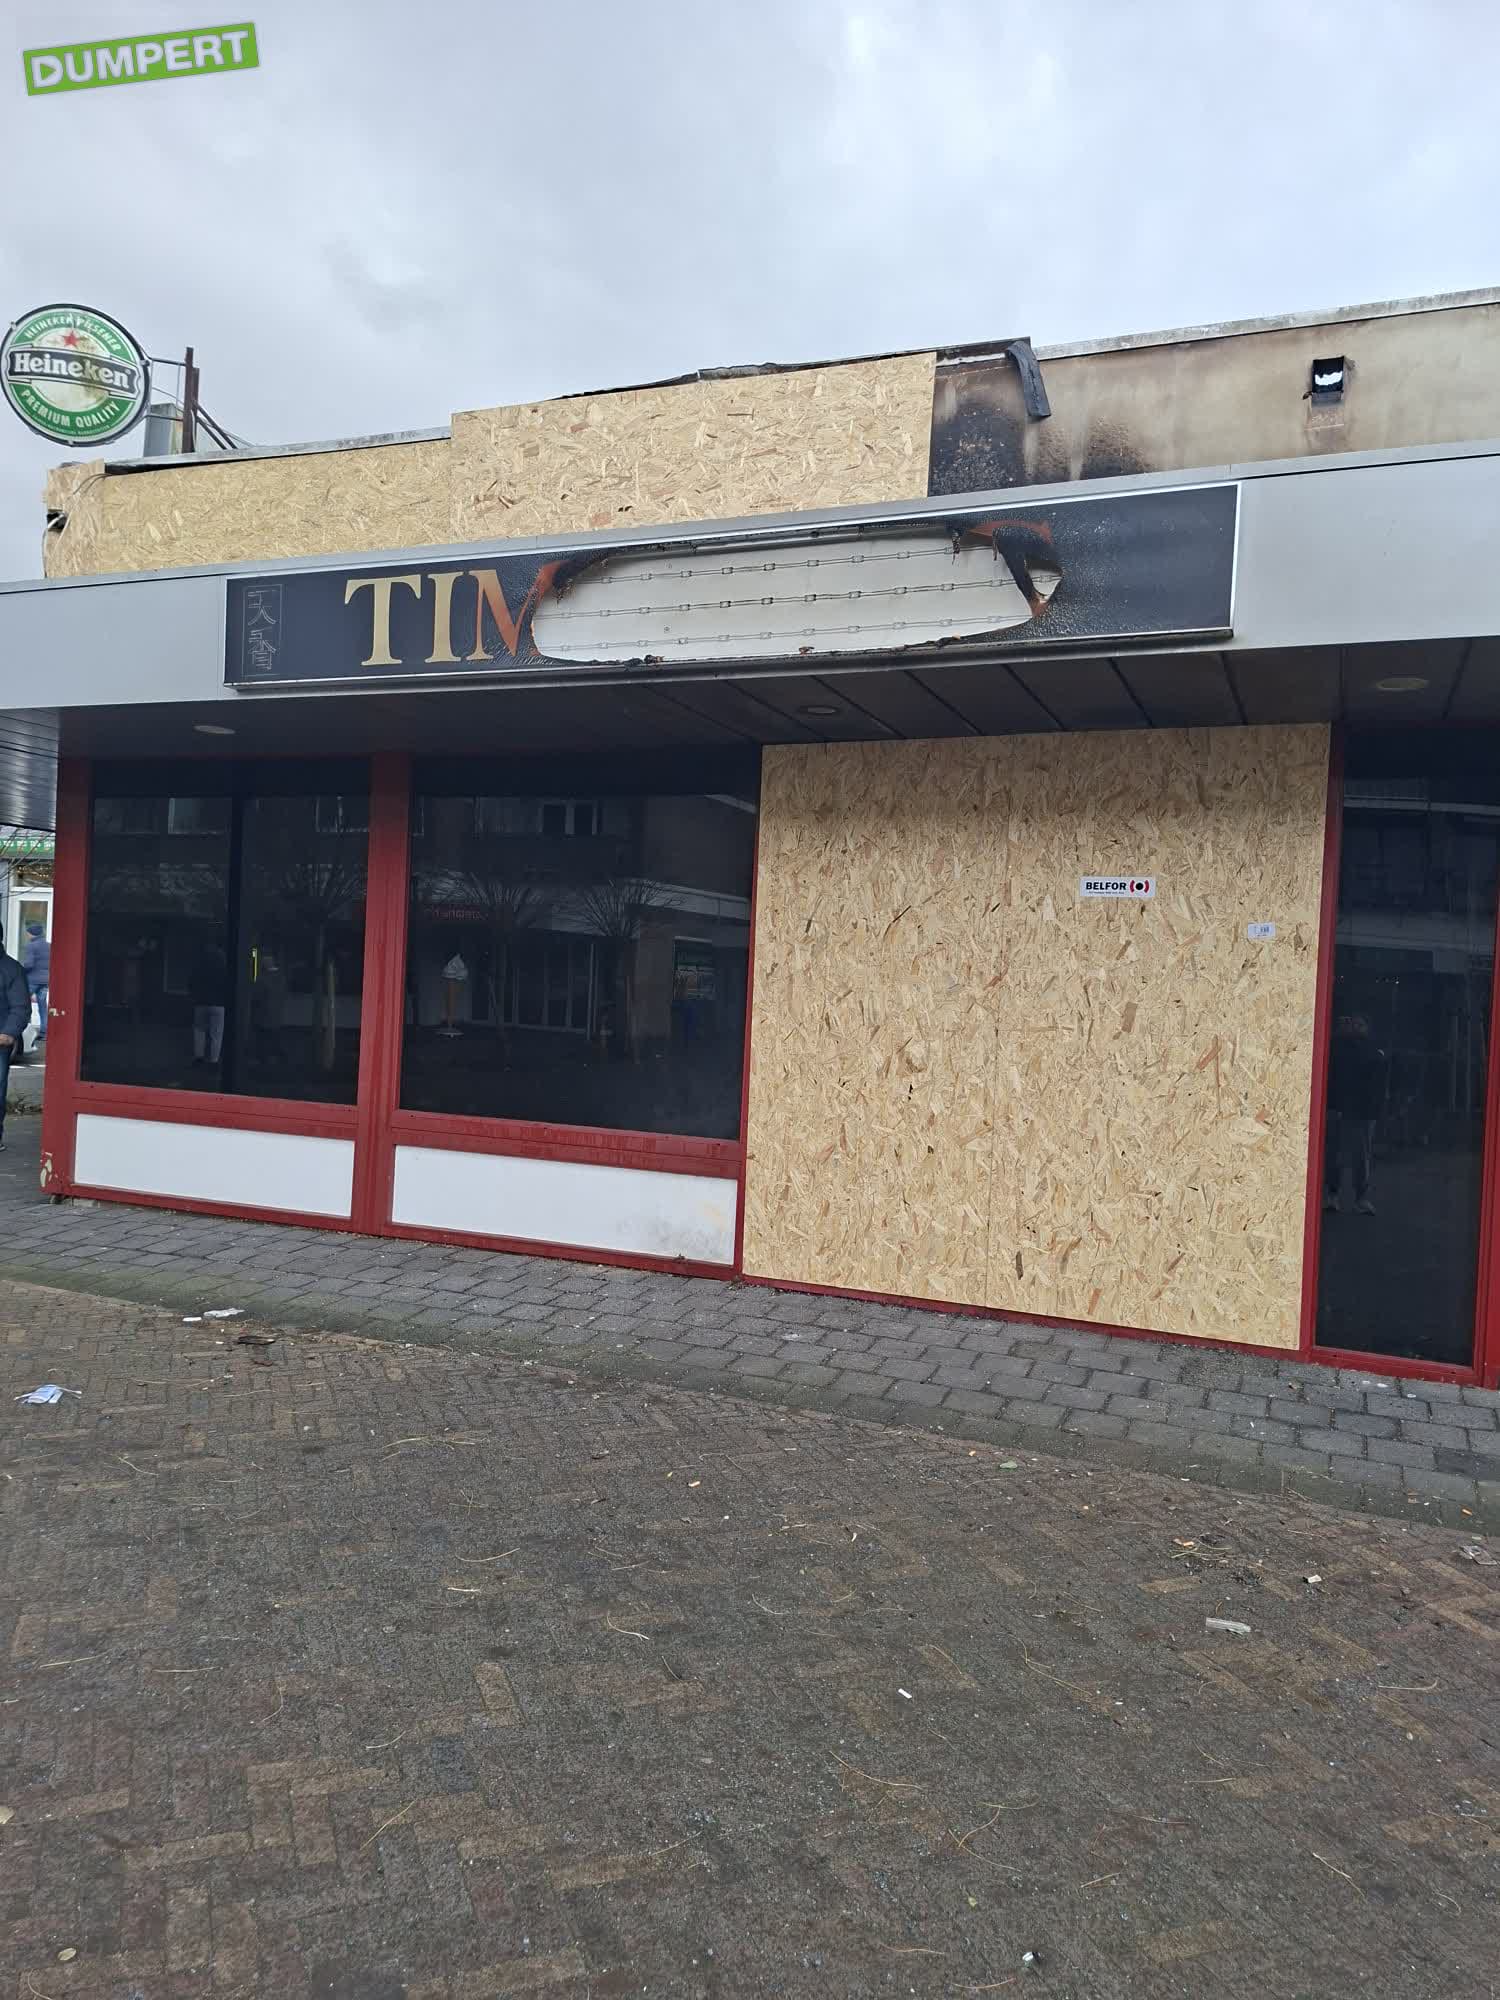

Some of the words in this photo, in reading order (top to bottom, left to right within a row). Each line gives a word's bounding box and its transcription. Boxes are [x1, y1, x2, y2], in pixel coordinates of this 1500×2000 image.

[25, 315, 73, 338] HEINEKEN
[76, 316, 121, 350] PILSENER
[14, 353, 129, 388] Heineken
[21, 389, 71, 426] PREMIUM
[75, 400, 120, 428] QUALITY
[1085, 881, 1127, 891] BELFOR
